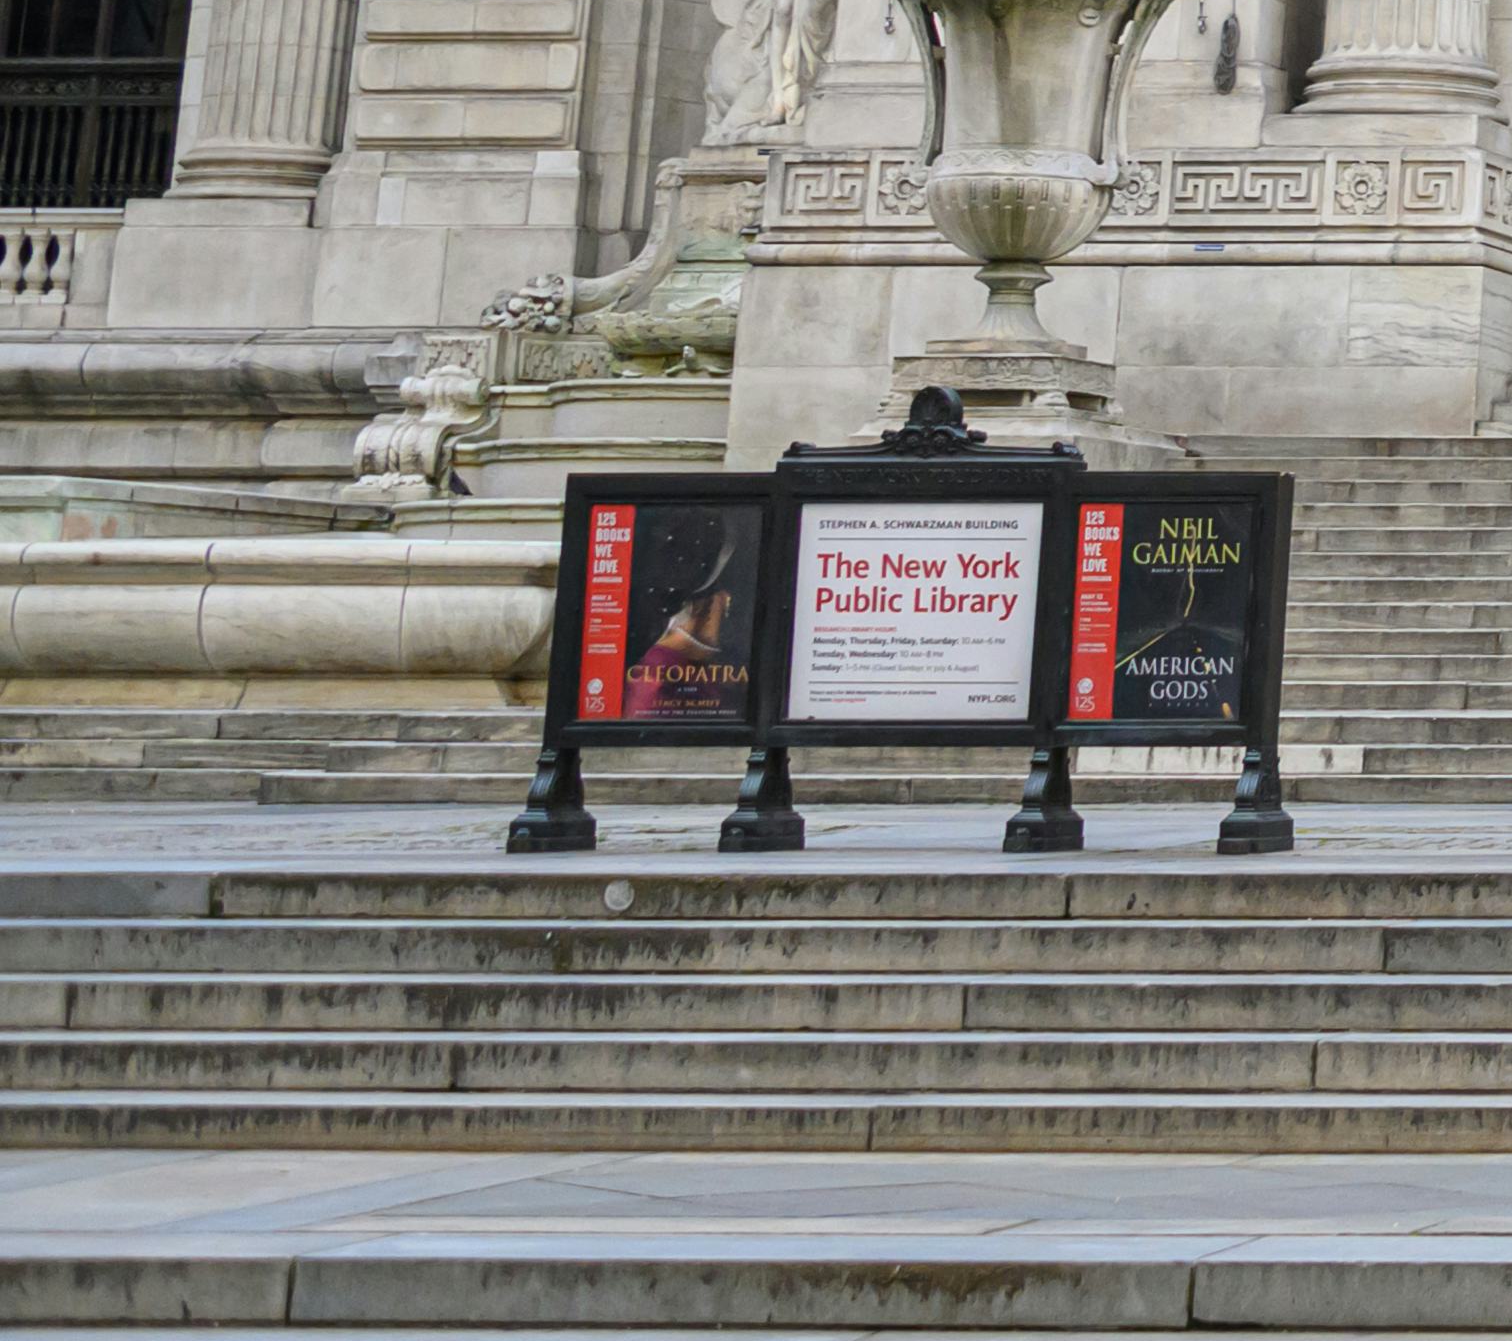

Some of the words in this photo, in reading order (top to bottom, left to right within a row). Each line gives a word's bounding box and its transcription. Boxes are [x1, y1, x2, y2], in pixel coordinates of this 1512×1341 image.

[597, 512, 616, 526] 125
[819, 520, 867, 529] STEPHEN
[870, 520, 880, 529] A.
[884, 520, 962, 529] SCHWARZMAN
[965, 520, 1019, 529] BUILDING
[1085, 511, 1105, 525] 125
[596, 528, 630, 542] BOOKS
[1084, 527, 1120, 541] BOOKS
[1160, 518, 1218, 540] NEIL
[594, 544, 612, 557] WE
[1083, 543, 1102, 556] WE
[1133, 543, 1240, 564] GAIMAN
[593, 560, 618, 573] LOVE
[817, 552, 869, 578] The
[881, 553, 947, 578] New
[957, 552, 1021, 578] York
[1082, 559, 1107, 573] LOVE
[815, 586, 903, 613] Public
[913, 586, 1018, 621] Library
[1125, 656, 1234, 676] AMERICAN
[626, 665, 749, 682] CLEOPATRA
[1150, 680, 1208, 699] GODS
[968, 694, 1016, 703] NYPL.ORG
